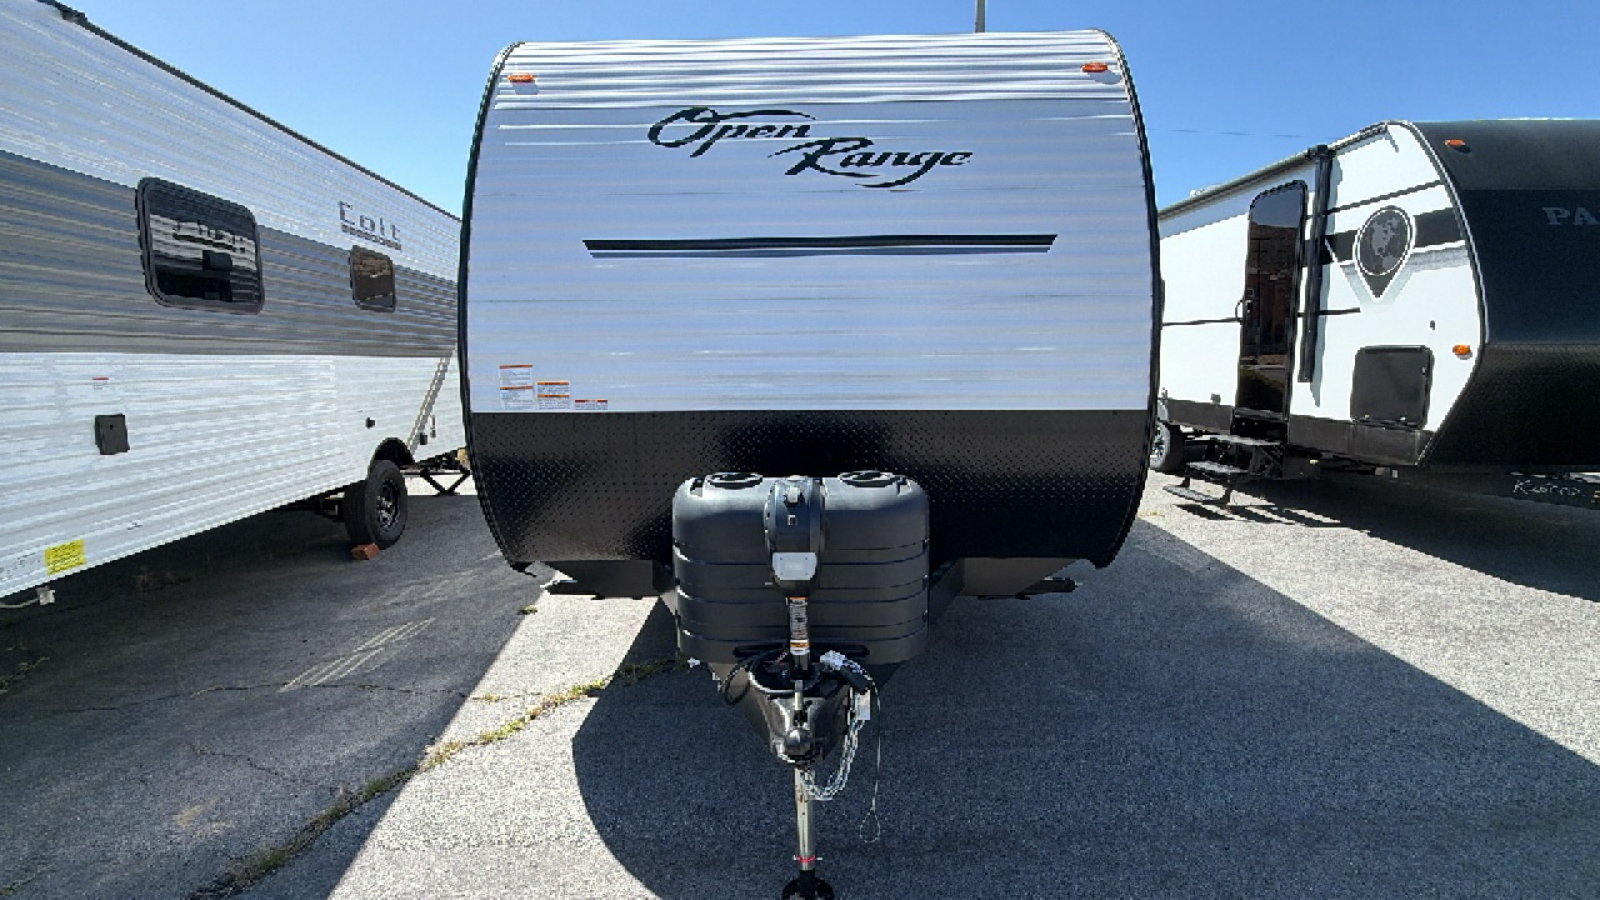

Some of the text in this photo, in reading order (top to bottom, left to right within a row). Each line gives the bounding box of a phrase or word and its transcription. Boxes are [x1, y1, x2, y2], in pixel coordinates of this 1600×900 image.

[648, 106, 816, 158] Open
[768, 136, 974, 188] Range
[339, 200, 401, 241] Colt
[1541, 206, 1600, 226] PA
